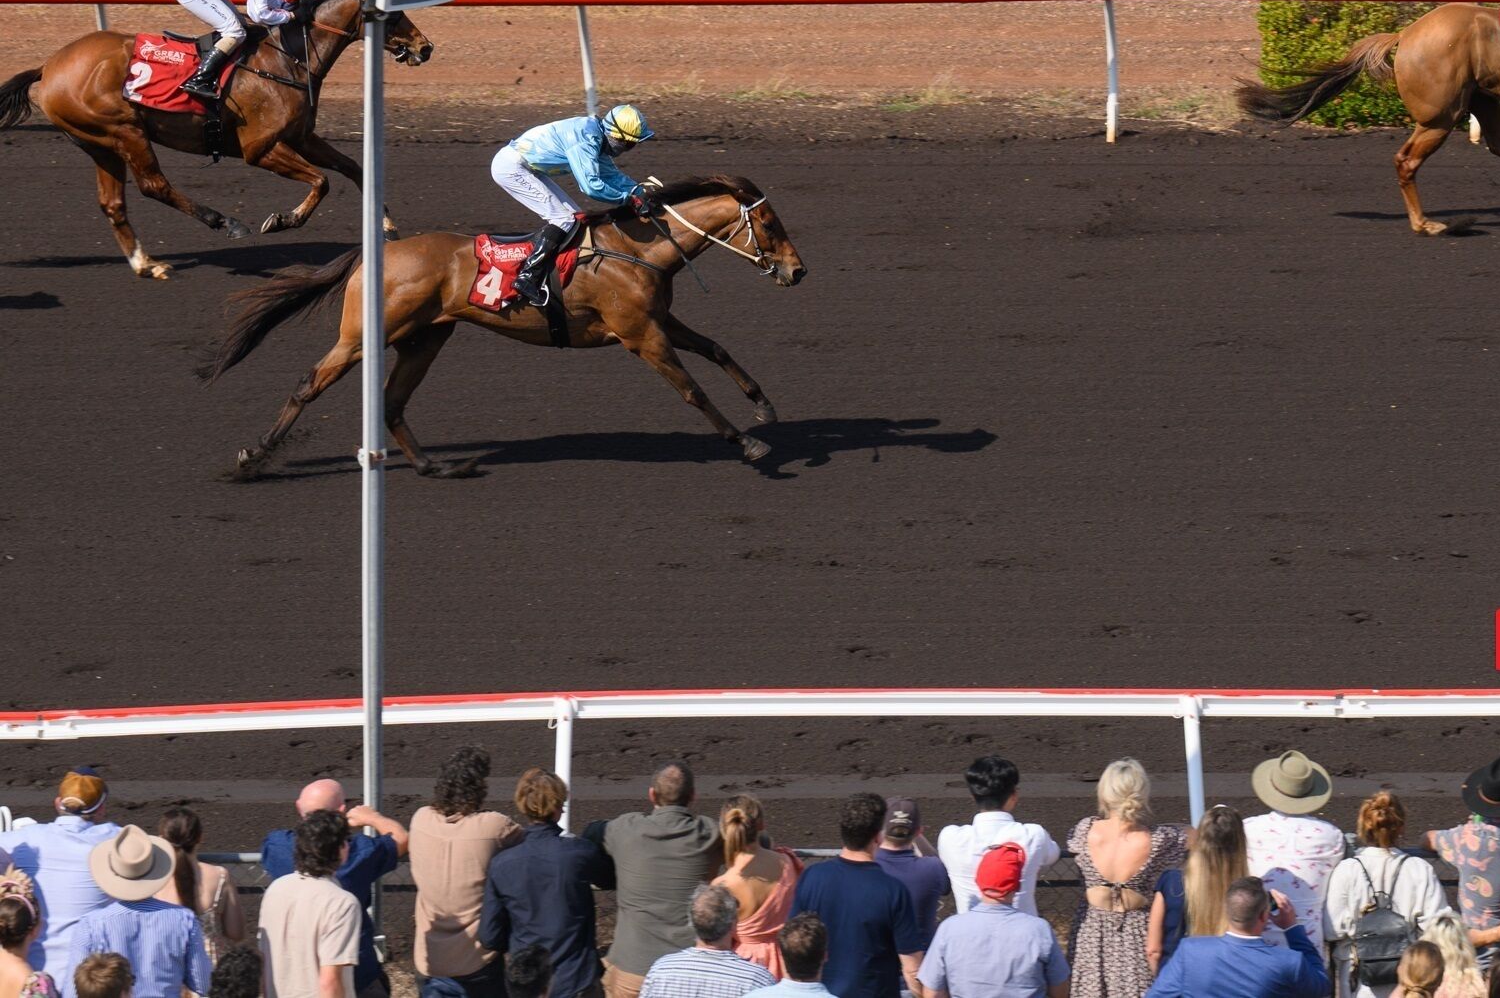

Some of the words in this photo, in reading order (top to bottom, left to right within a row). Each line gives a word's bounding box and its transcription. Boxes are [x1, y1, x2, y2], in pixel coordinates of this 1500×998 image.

[153, 50, 186, 60] GREAT
[122, 62, 152, 102] 2
[494, 247, 527, 257] GREAT
[476, 266, 503, 306] 4
